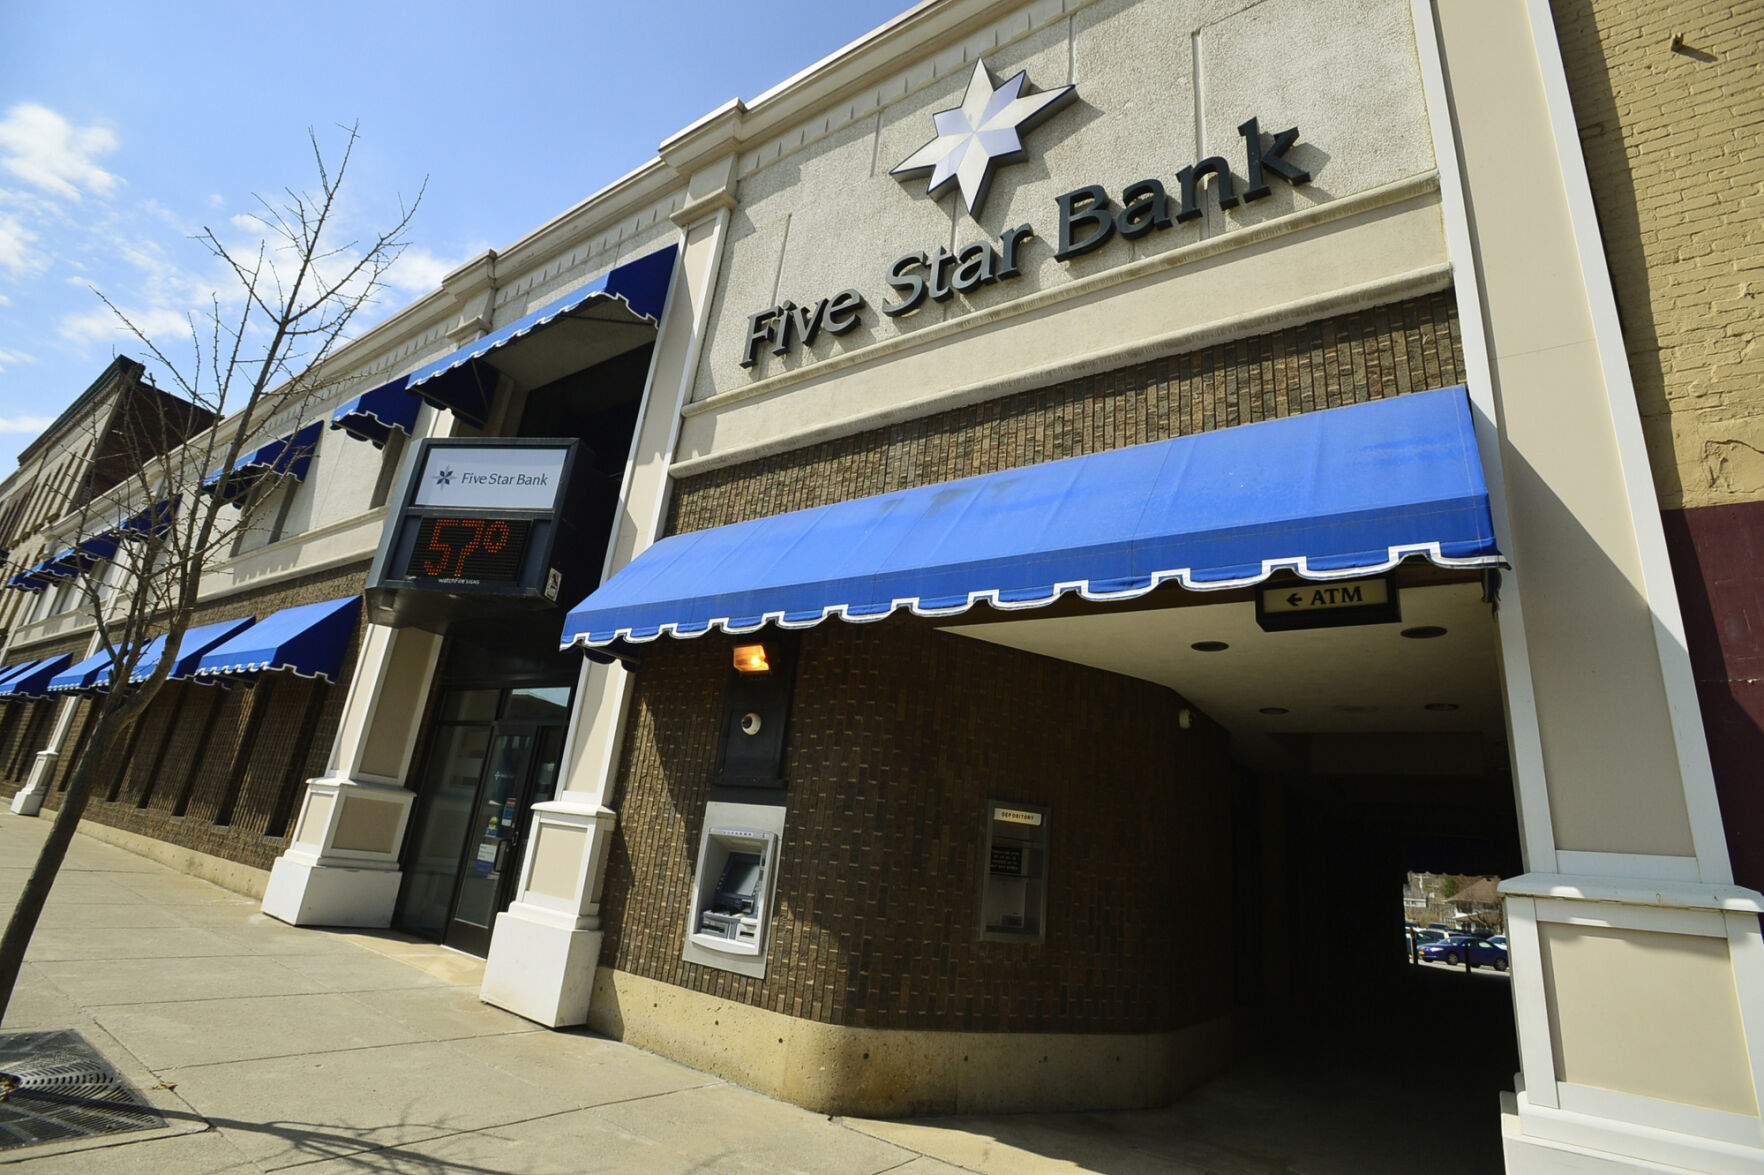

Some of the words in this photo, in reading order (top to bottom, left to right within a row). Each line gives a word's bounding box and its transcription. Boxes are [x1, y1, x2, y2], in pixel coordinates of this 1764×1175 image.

[739, 288, 866, 369] Five
[882, 224, 1034, 318] Star
[1055, 116, 1311, 262] Bank
[461, 473, 487, 485] Five
[488, 473, 515, 485] Star
[516, 473, 548, 486] Bank
[1311, 586, 1363, 606] ATM
